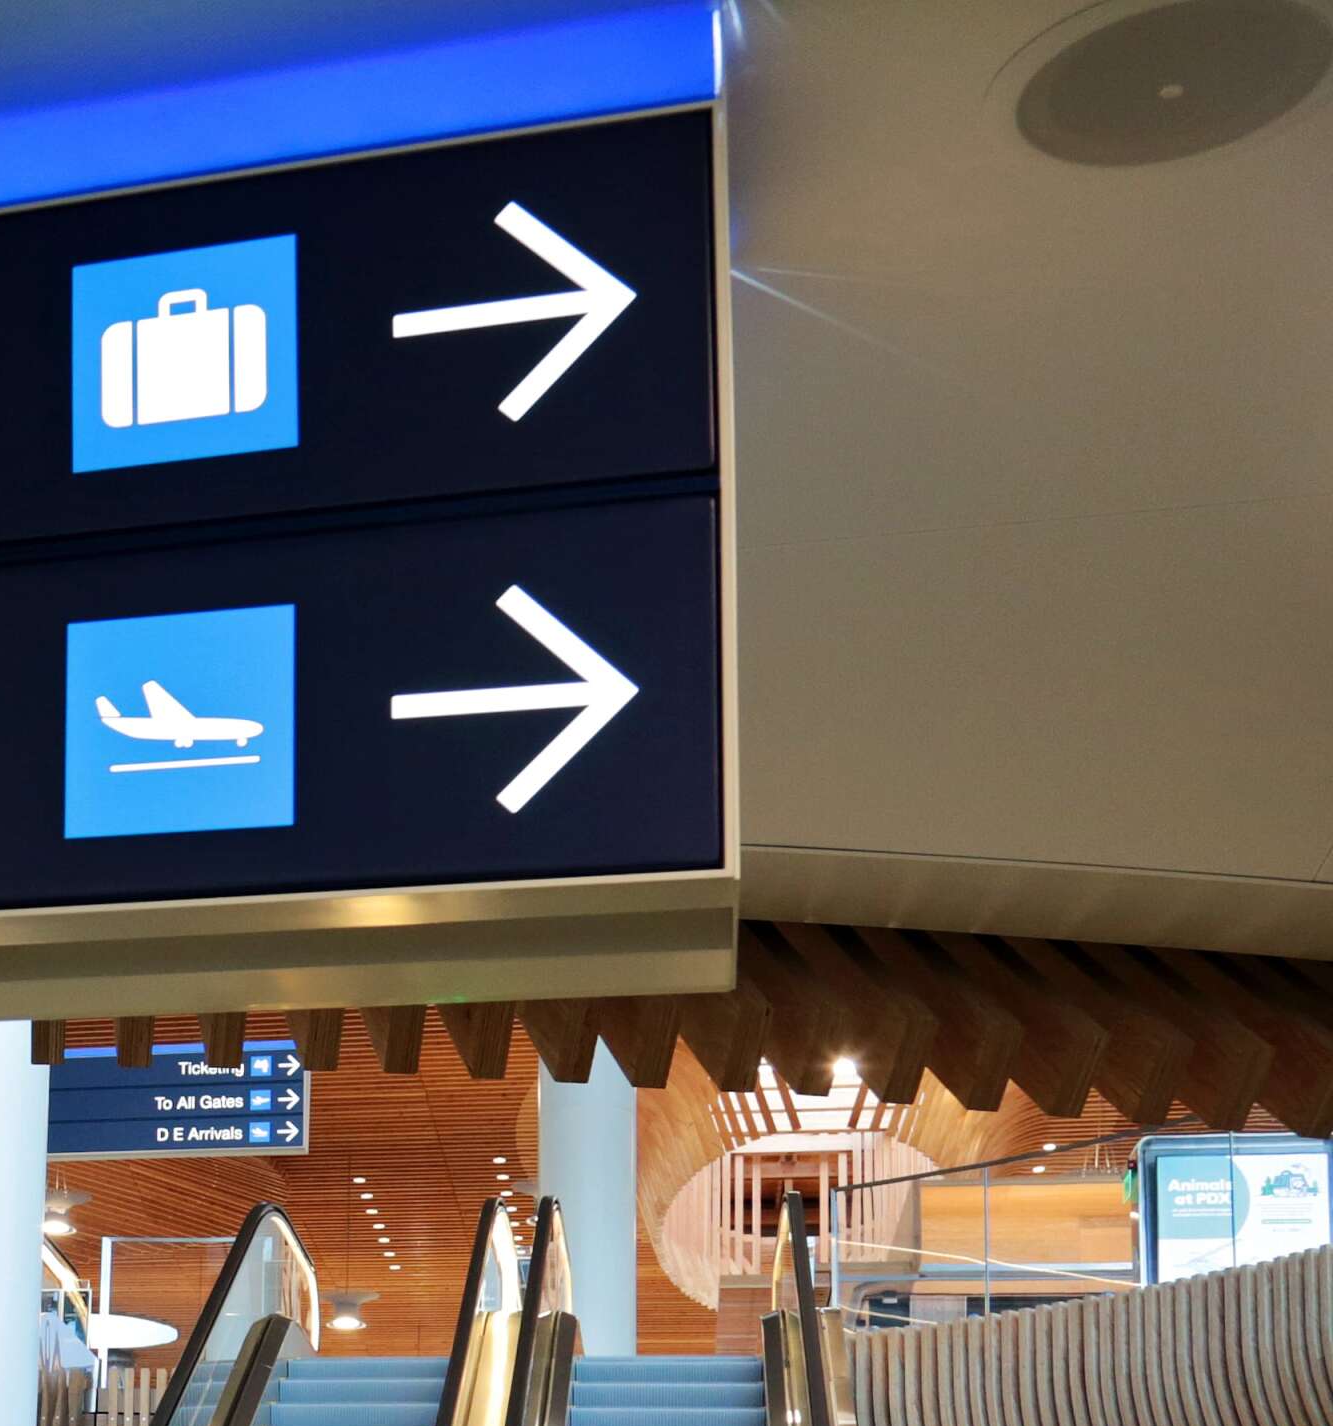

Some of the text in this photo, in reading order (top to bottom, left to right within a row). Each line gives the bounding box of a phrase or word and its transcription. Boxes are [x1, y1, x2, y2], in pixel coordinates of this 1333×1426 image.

[154, 1094, 244, 1110] To All Gates
[156, 1125, 243, 1142] D E Arrivals
